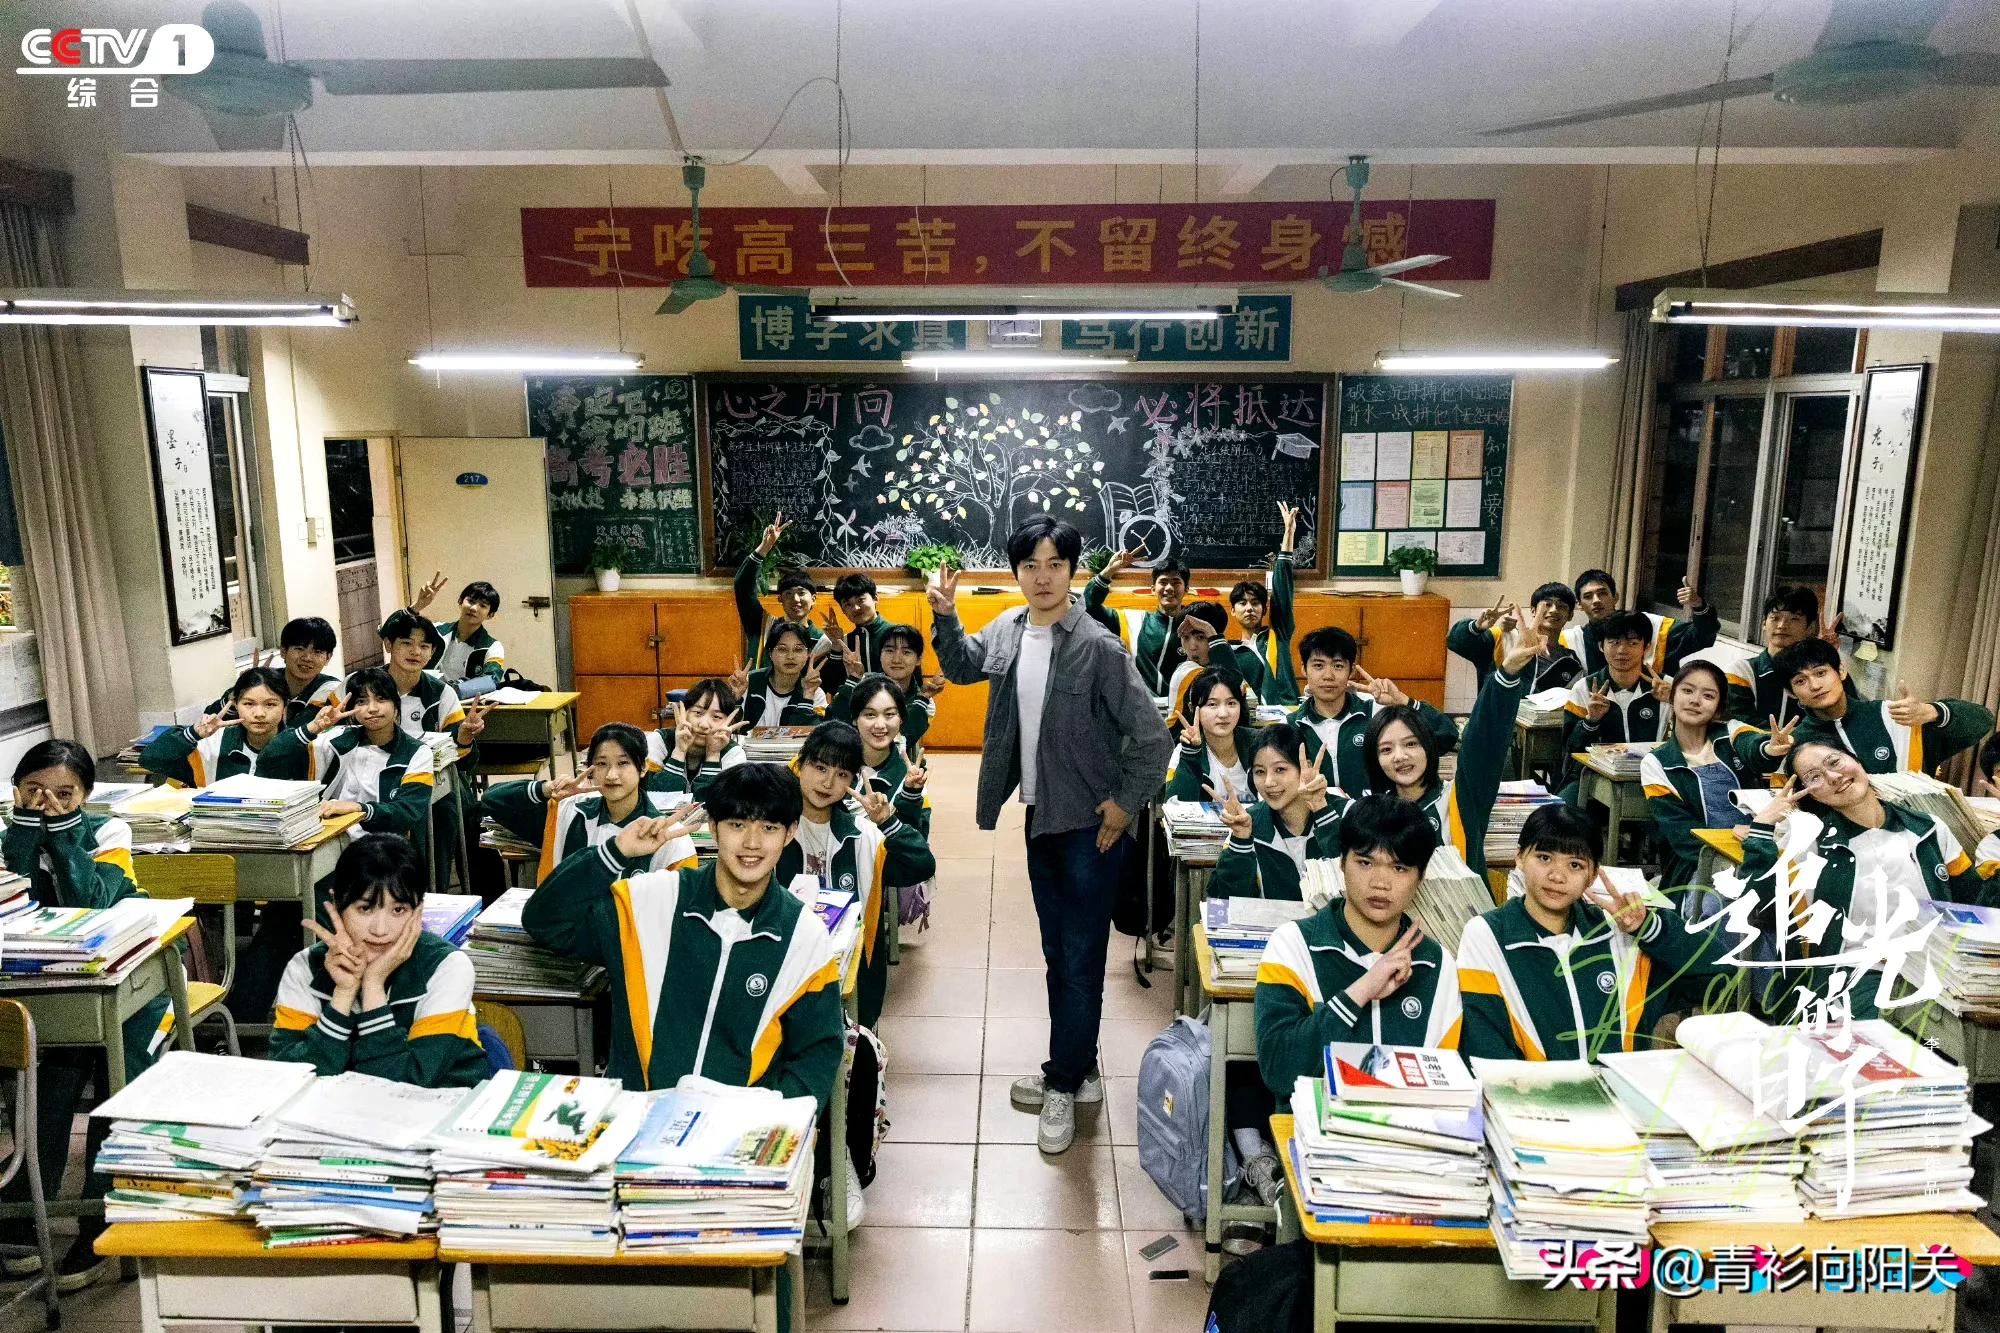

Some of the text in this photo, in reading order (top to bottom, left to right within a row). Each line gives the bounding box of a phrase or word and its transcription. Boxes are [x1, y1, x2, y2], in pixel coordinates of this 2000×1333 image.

[723, 384, 893, 428] 心之所向
[1134, 384, 1320, 433] 必将抵达
[464, 475, 481, 483] 217
[547, 443, 693, 488] 高考必胜
